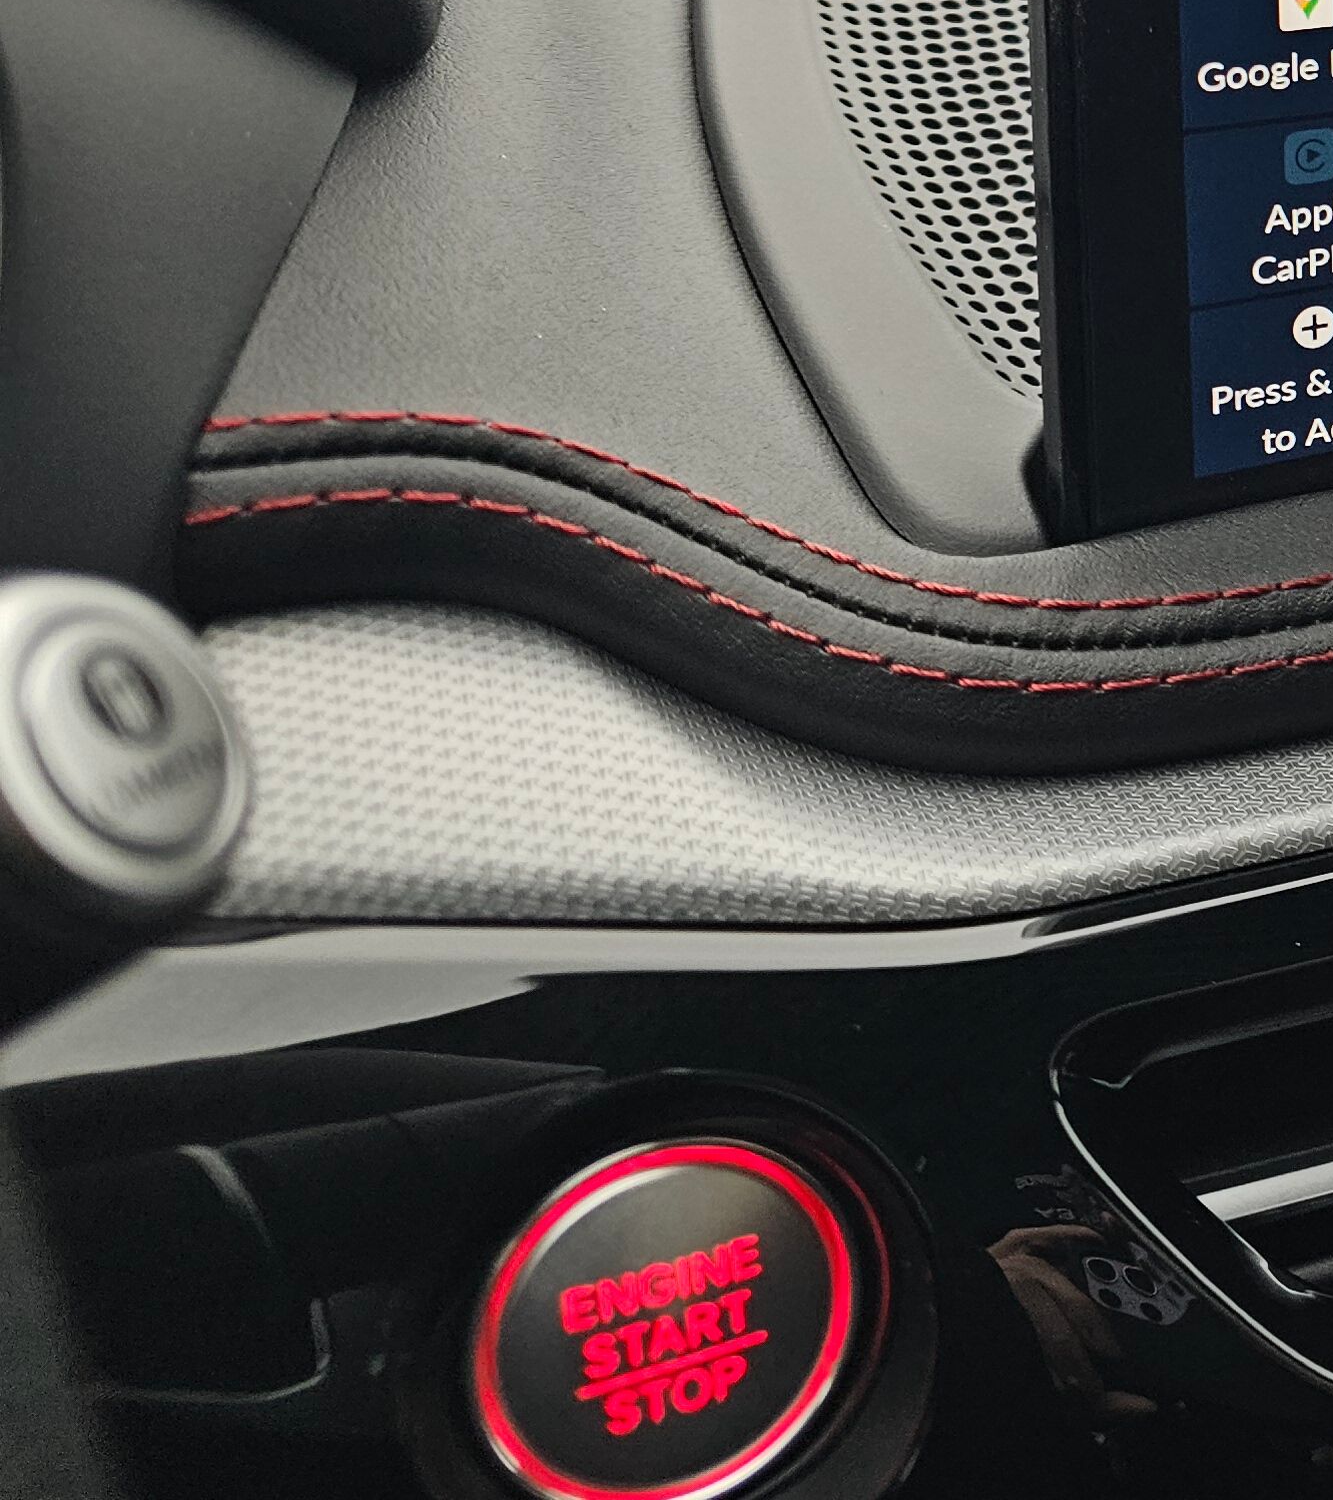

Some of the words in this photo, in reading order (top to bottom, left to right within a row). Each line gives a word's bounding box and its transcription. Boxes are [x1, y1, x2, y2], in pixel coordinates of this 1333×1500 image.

[1197, 51, 1320, 92] Google
[1211, 380, 1297, 416] Press
[1306, 368, 1333, 397] &
[1261, 428, 1297, 455] to
[561, 1233, 763, 1334] ENGINE
[582, 1288, 752, 1379] START
[604, 1355, 747, 1435] STOP
